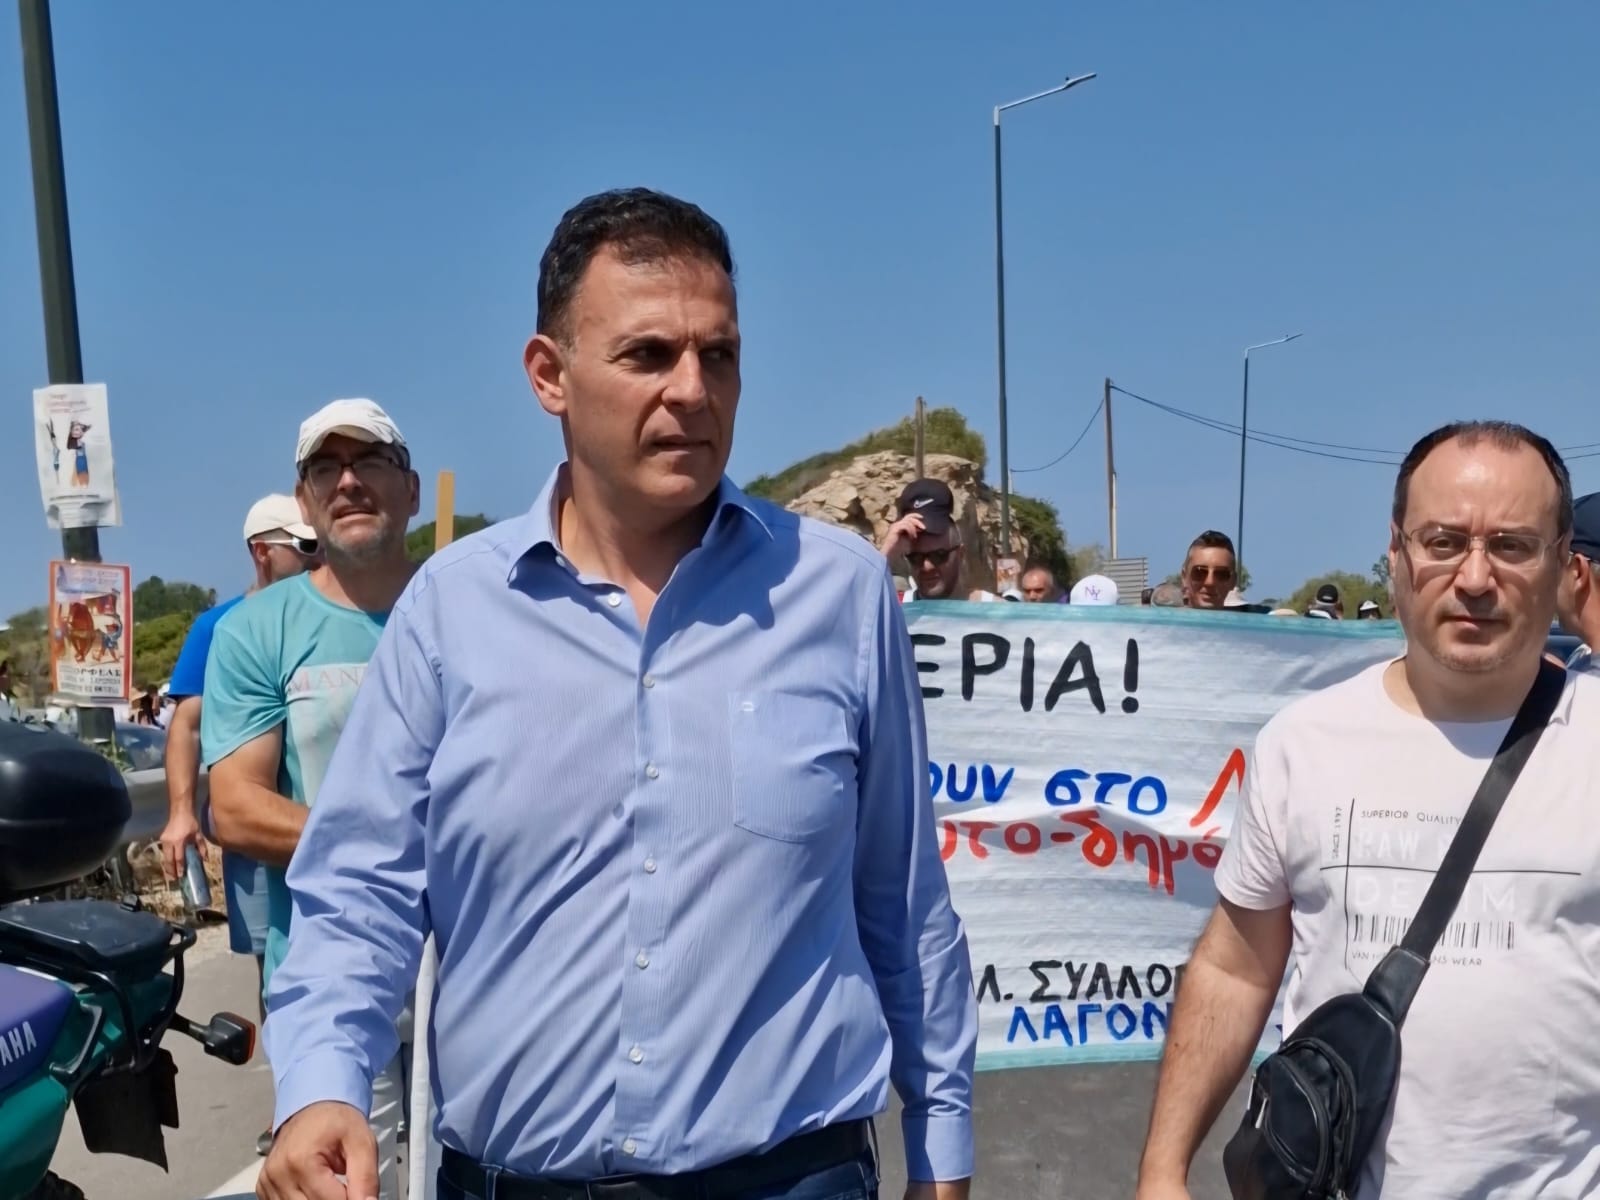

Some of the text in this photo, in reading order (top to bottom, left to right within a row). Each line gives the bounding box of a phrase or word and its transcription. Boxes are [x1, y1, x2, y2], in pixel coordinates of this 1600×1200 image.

[911, 632, 1139, 714] ΕΡΙΑ!
[1045, 768, 1168, 816] στο
[1360, 809, 1410, 819] SUPERIOR
